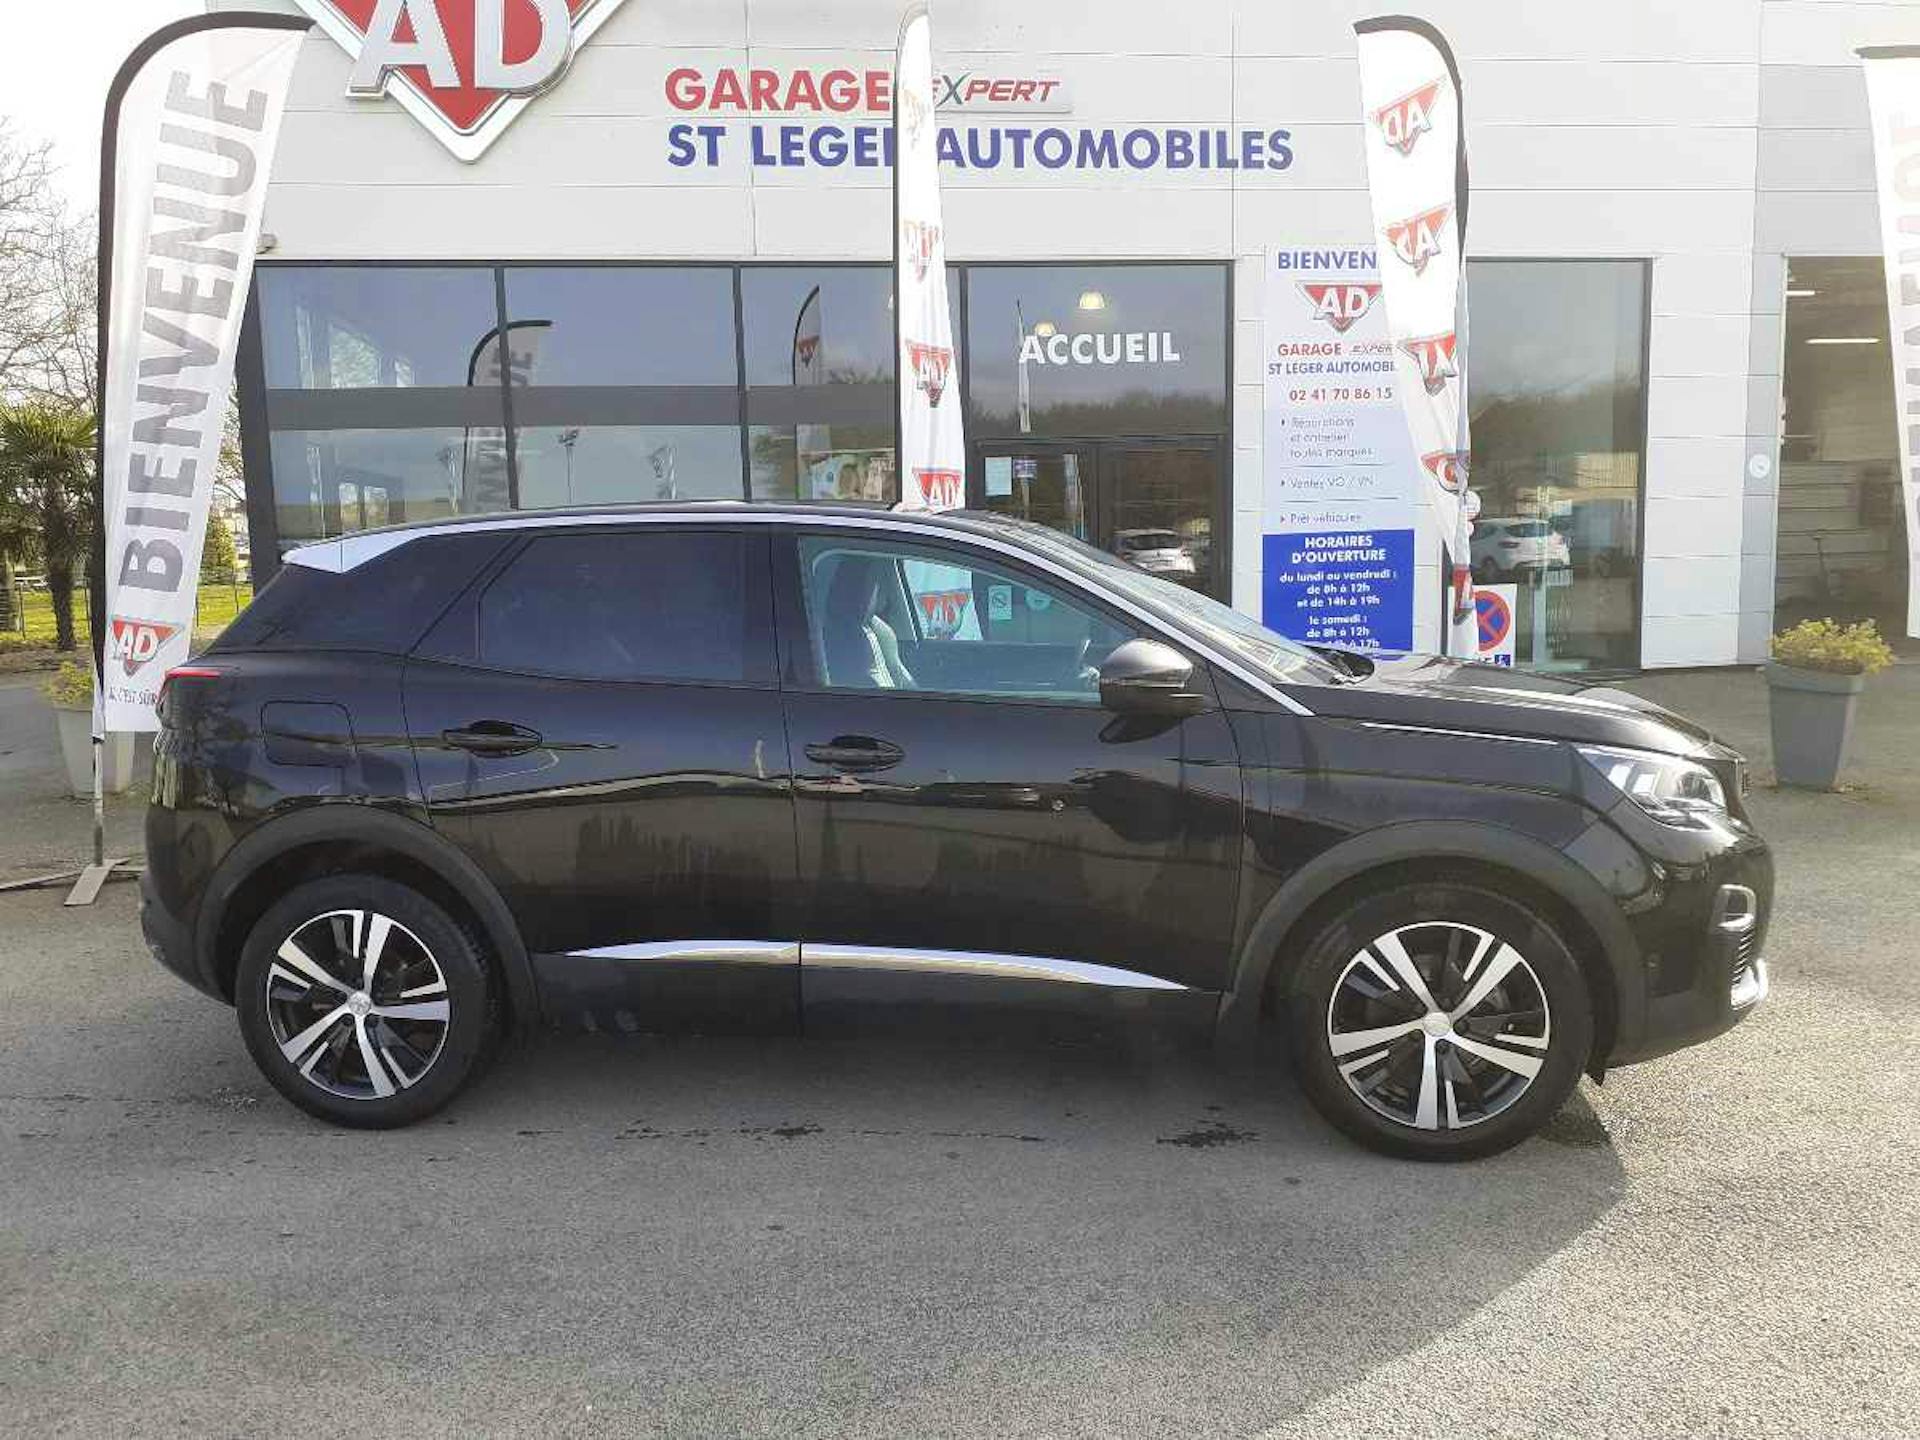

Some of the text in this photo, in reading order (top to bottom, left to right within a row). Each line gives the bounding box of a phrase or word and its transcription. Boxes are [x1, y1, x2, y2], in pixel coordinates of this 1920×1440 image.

[347, 0, 573, 95] AD
[665, 68, 891, 113] GARAGE
[668, 126, 726, 168] ST
[937, 127, 1294, 171] AUTOMOBILES
[1278, 250, 1377, 270] BIENVEN
[1314, 285, 1370, 320] AD
[118, 69, 268, 593] BIENVENUE
[1018, 331, 1181, 365] ACCUEIL
[1278, 343, 1393, 356] GARAGE EXPER
[918, 351, 946, 386] AD
[1268, 360, 1395, 375] ST LEGER AUTOMOBI
[1289, 389, 1307, 401] 02
[1311, 388, 1326, 400] 41
[1333, 387, 1350, 400] 70
[1354, 387, 1371, 399] 86
[1304, 535, 1373, 549] HORAIRES
[1292, 549, 1387, 564] D'OUVERTURE
[1280, 573, 1294, 583] du
[1297, 570, 1325, 582] lundi
[1327, 572, 1341, 580] au
[1307, 584, 1321, 595] de
[1351, 582, 1371, 593] 12h
[1310, 597, 1324, 607] de
[1309, 615, 1320, 625] le
[1322, 613, 1361, 624] samedi
[1307, 628, 1321, 638] de
[1351, 626, 1370, 637] 12h
[113, 624, 161, 662] AD
